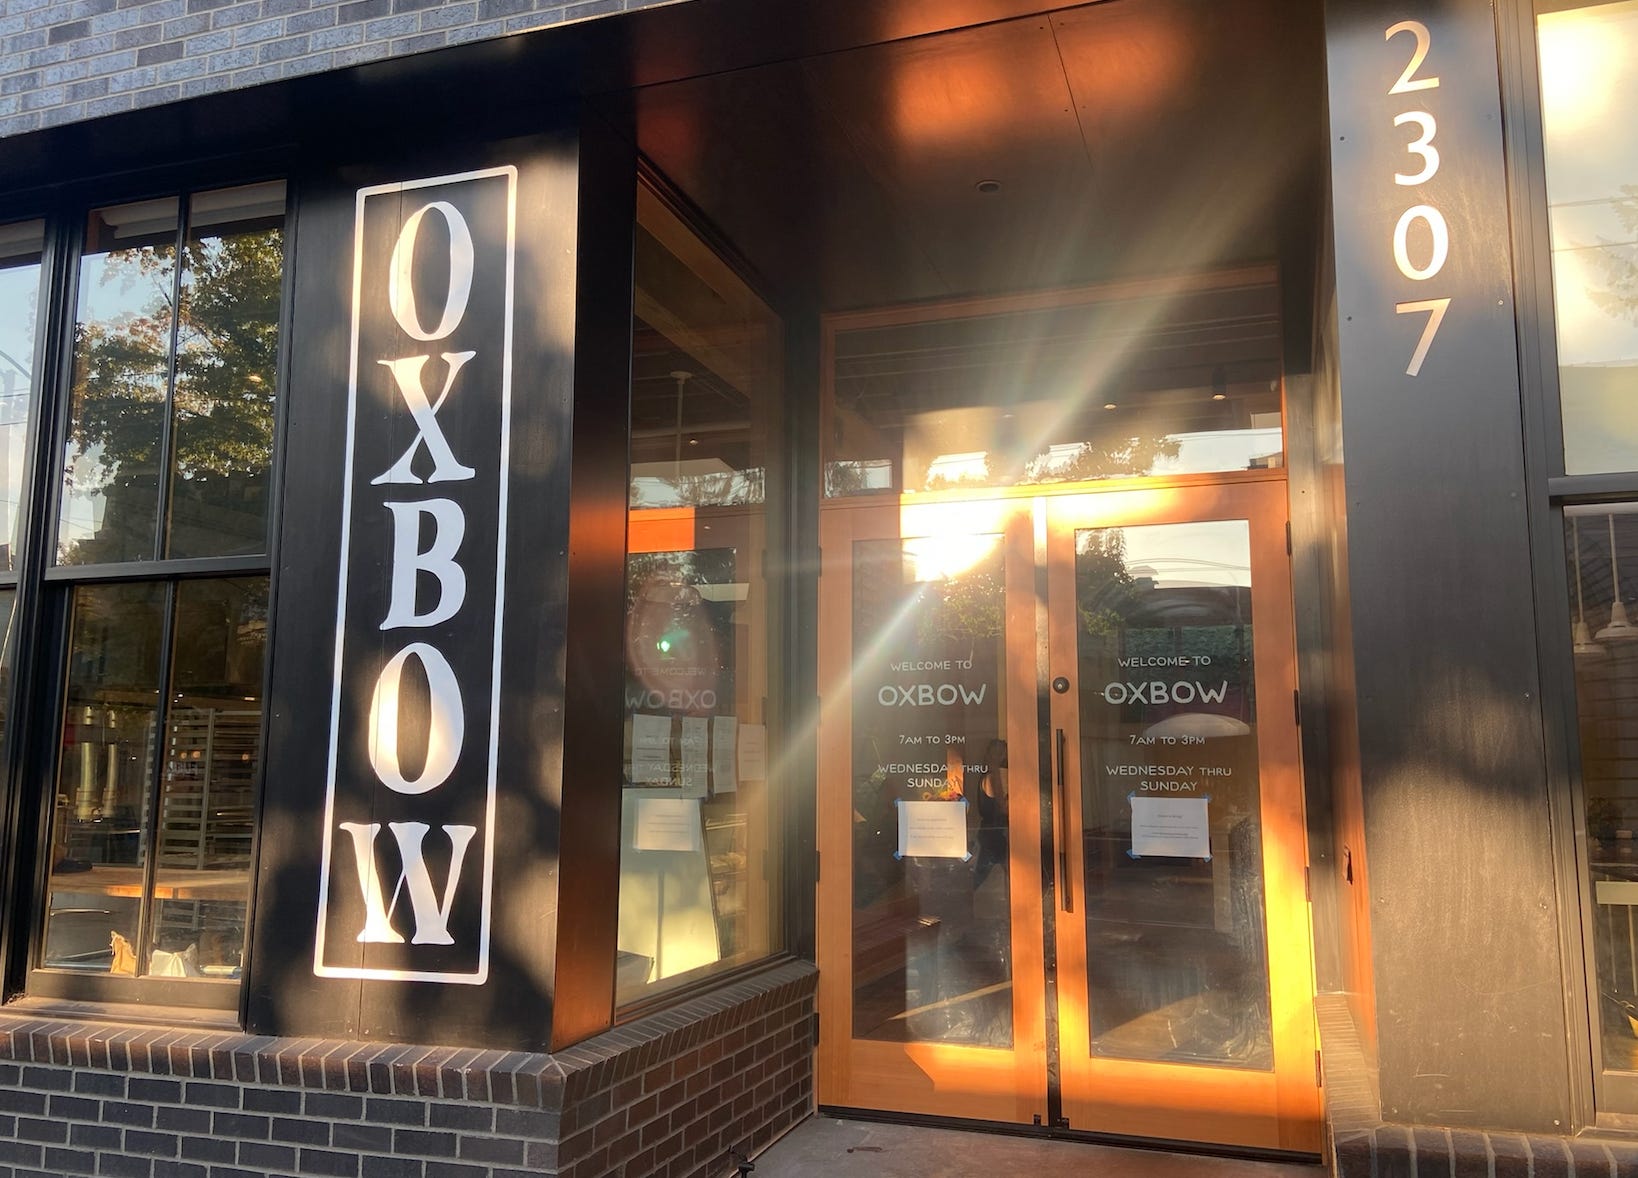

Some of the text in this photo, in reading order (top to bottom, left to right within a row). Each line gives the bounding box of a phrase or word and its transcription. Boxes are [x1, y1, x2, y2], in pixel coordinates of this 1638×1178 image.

[1385, 20, 1451, 377] 2307
[338, 201, 476, 945] OXBOW
[890, 660, 973, 671] WELCOME TO
[1117, 655, 1211, 667] WELCOME TO
[878, 683, 987, 706] OXBOW
[1104, 680, 1228, 705] OXBOW
[898, 734, 966, 745] 7AM TO 3PM
[1129, 734, 1206, 745] 7AM TO 3PM
[878, 763, 988, 774] WEDNESDA THRU
[1105, 764, 1232, 777] WEDNESDAY THRU
[1140, 780, 1198, 792] SUNDAY
